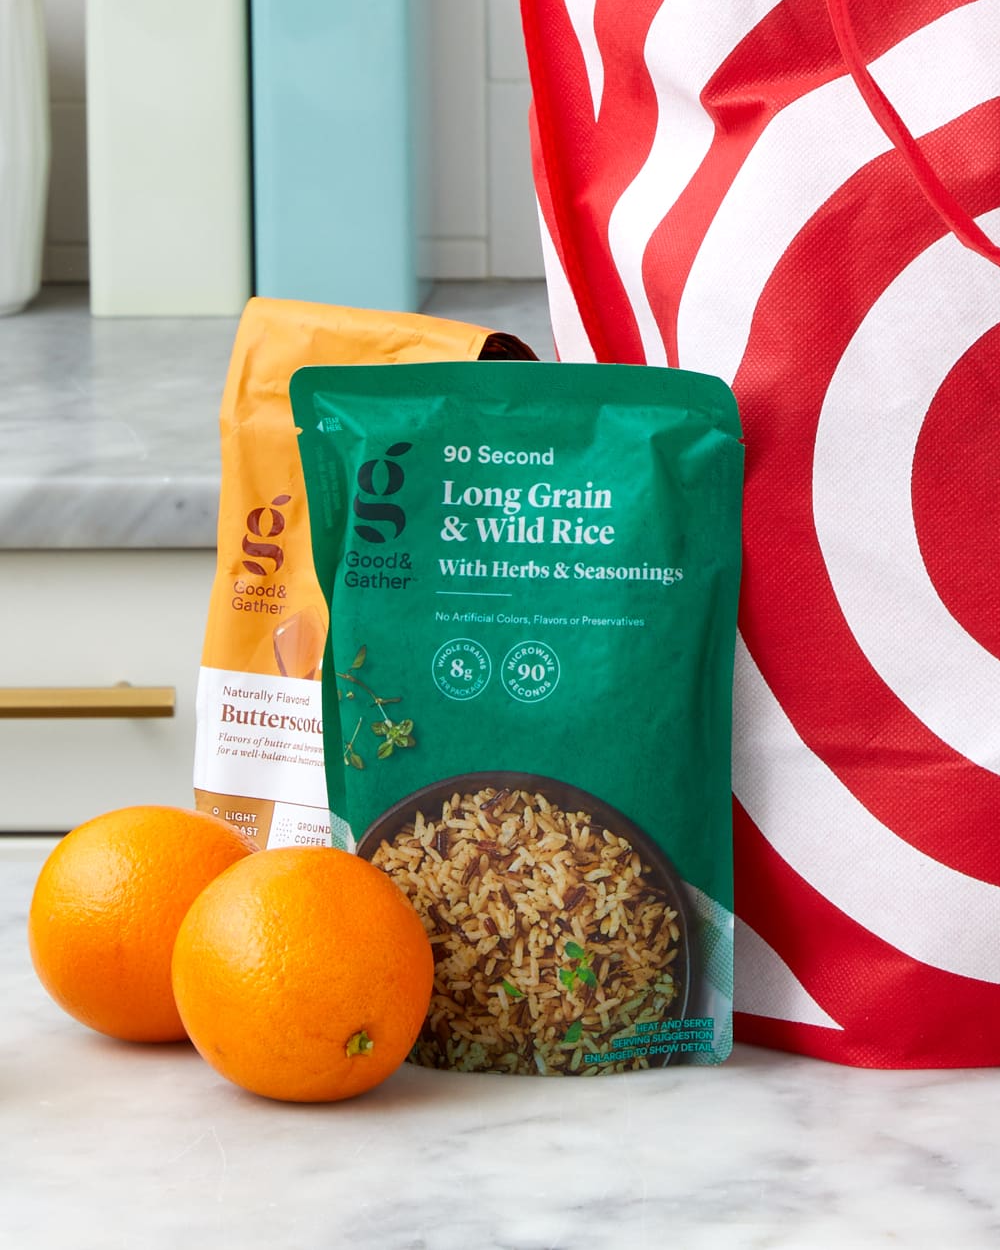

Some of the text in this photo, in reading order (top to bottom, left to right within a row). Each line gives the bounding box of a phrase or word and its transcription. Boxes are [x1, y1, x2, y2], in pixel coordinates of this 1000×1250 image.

[443, 444, 555, 466] 90 Second
[442, 480, 612, 516] Long Grain
[440, 515, 616, 546] & Wild Rice
[438, 558, 684, 586] With Herbs & Seasonings
[435, 611, 645, 627] No Artificial Colors, Flavors or Preservatives
[437, 644, 487, 670] WHOLE GRAINS
[507, 646, 555, 672] MICROWAVE
[517, 663, 546, 682] 90
[223, 685, 310, 707] Naturally Flavored
[439, 676, 484, 697] PER PACKAGE
[508, 678, 551, 698] SECONDS
[218, 732, 251, 745] Flavors
[252, 735, 264, 748] of
[264, 738, 292, 750] butter
[217, 744, 229, 756] for
[240, 747, 298, 763] well-balanced
[225, 811, 257, 823] LIGHT
[297, 822, 332, 835] GROUND
[294, 835, 326, 847] COFFEE
[636, 1018, 714, 1033] HEAT AND SERVE
[612, 1030, 714, 1049] SERVING SUGGESTION
[583, 1042, 714, 1064] ENLARGED TO SHOW DETAIL
